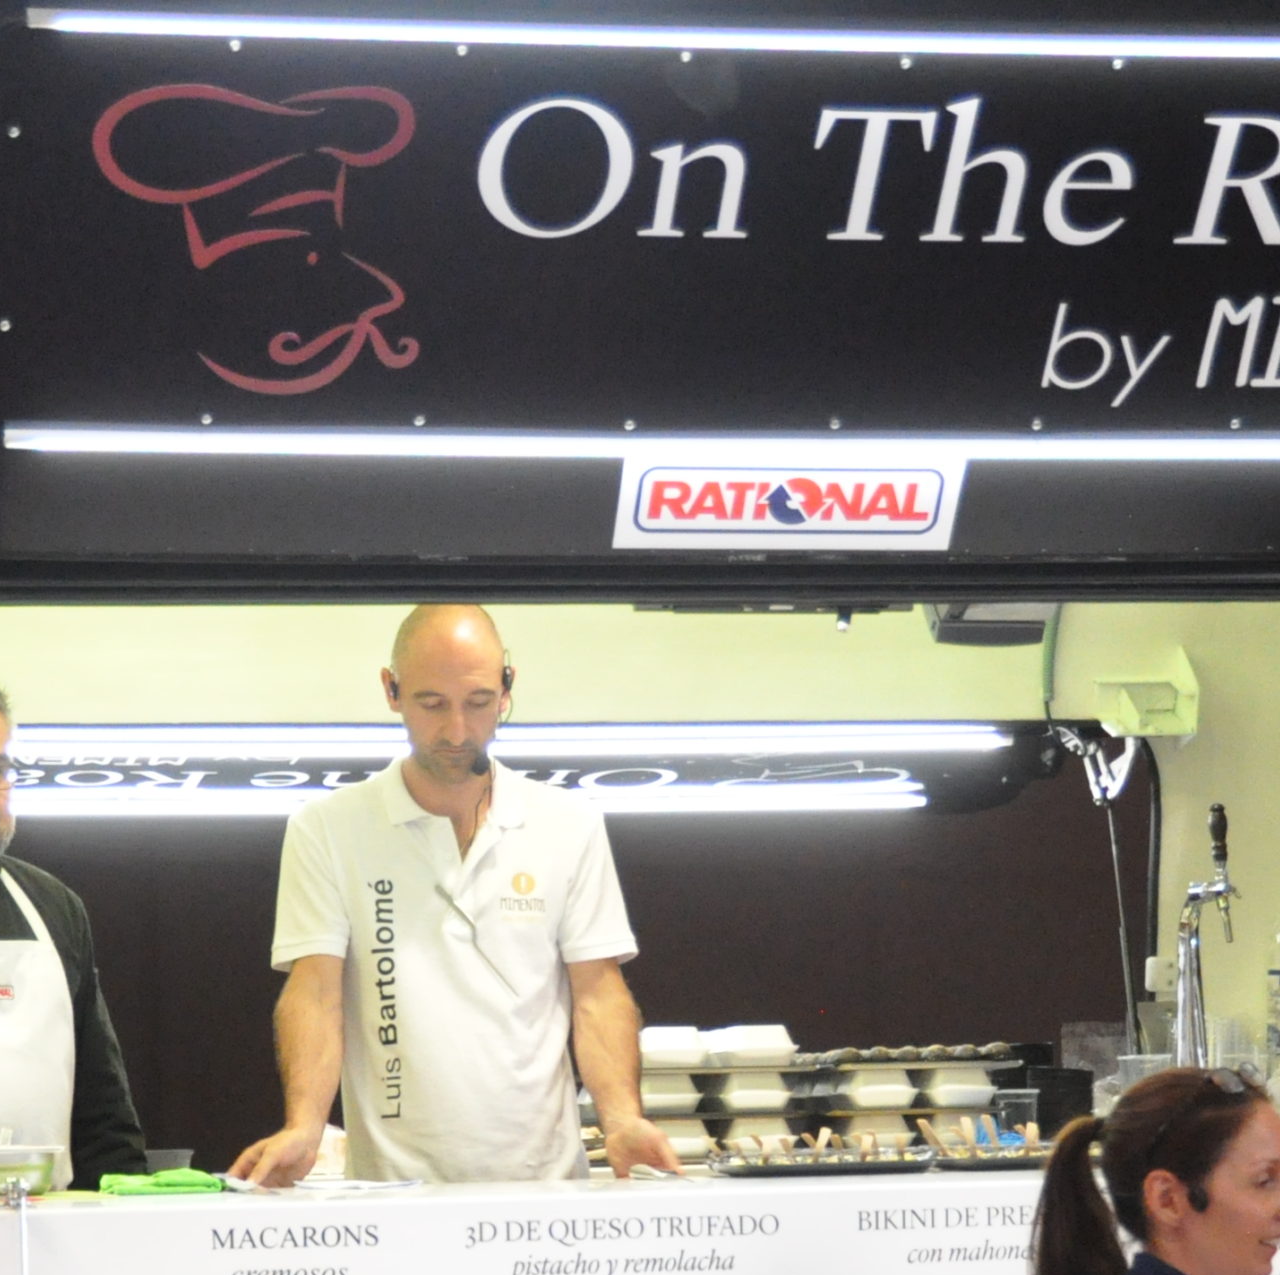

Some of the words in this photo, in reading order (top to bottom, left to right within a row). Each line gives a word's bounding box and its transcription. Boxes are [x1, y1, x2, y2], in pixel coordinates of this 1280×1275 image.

[478, 98, 747, 238] On
[813, 97, 1135, 247] The
[1041, 302, 1171, 408] by
[646, 476, 929, 526] RATIONAL
[367, 878, 398, 1046] Bartolomé
[380, 1057, 401, 1119] Luis
[210, 1225, 379, 1250] MACARONS
[465, 1222, 497, 1248] 3D
[505, 1220, 542, 1242] DE
[547, 1217, 644, 1244] QUESO
[648, 1213, 780, 1239] TRUFADO
[856, 1209, 937, 1232] BIKINI
[944, 1207, 978, 1229] DE
[985, 1205, 1040, 1227] PRE
[623, 1250, 735, 1275] remolacha
[907, 1246, 943, 1264] con
[947, 1239, 1032, 1262] mahone
